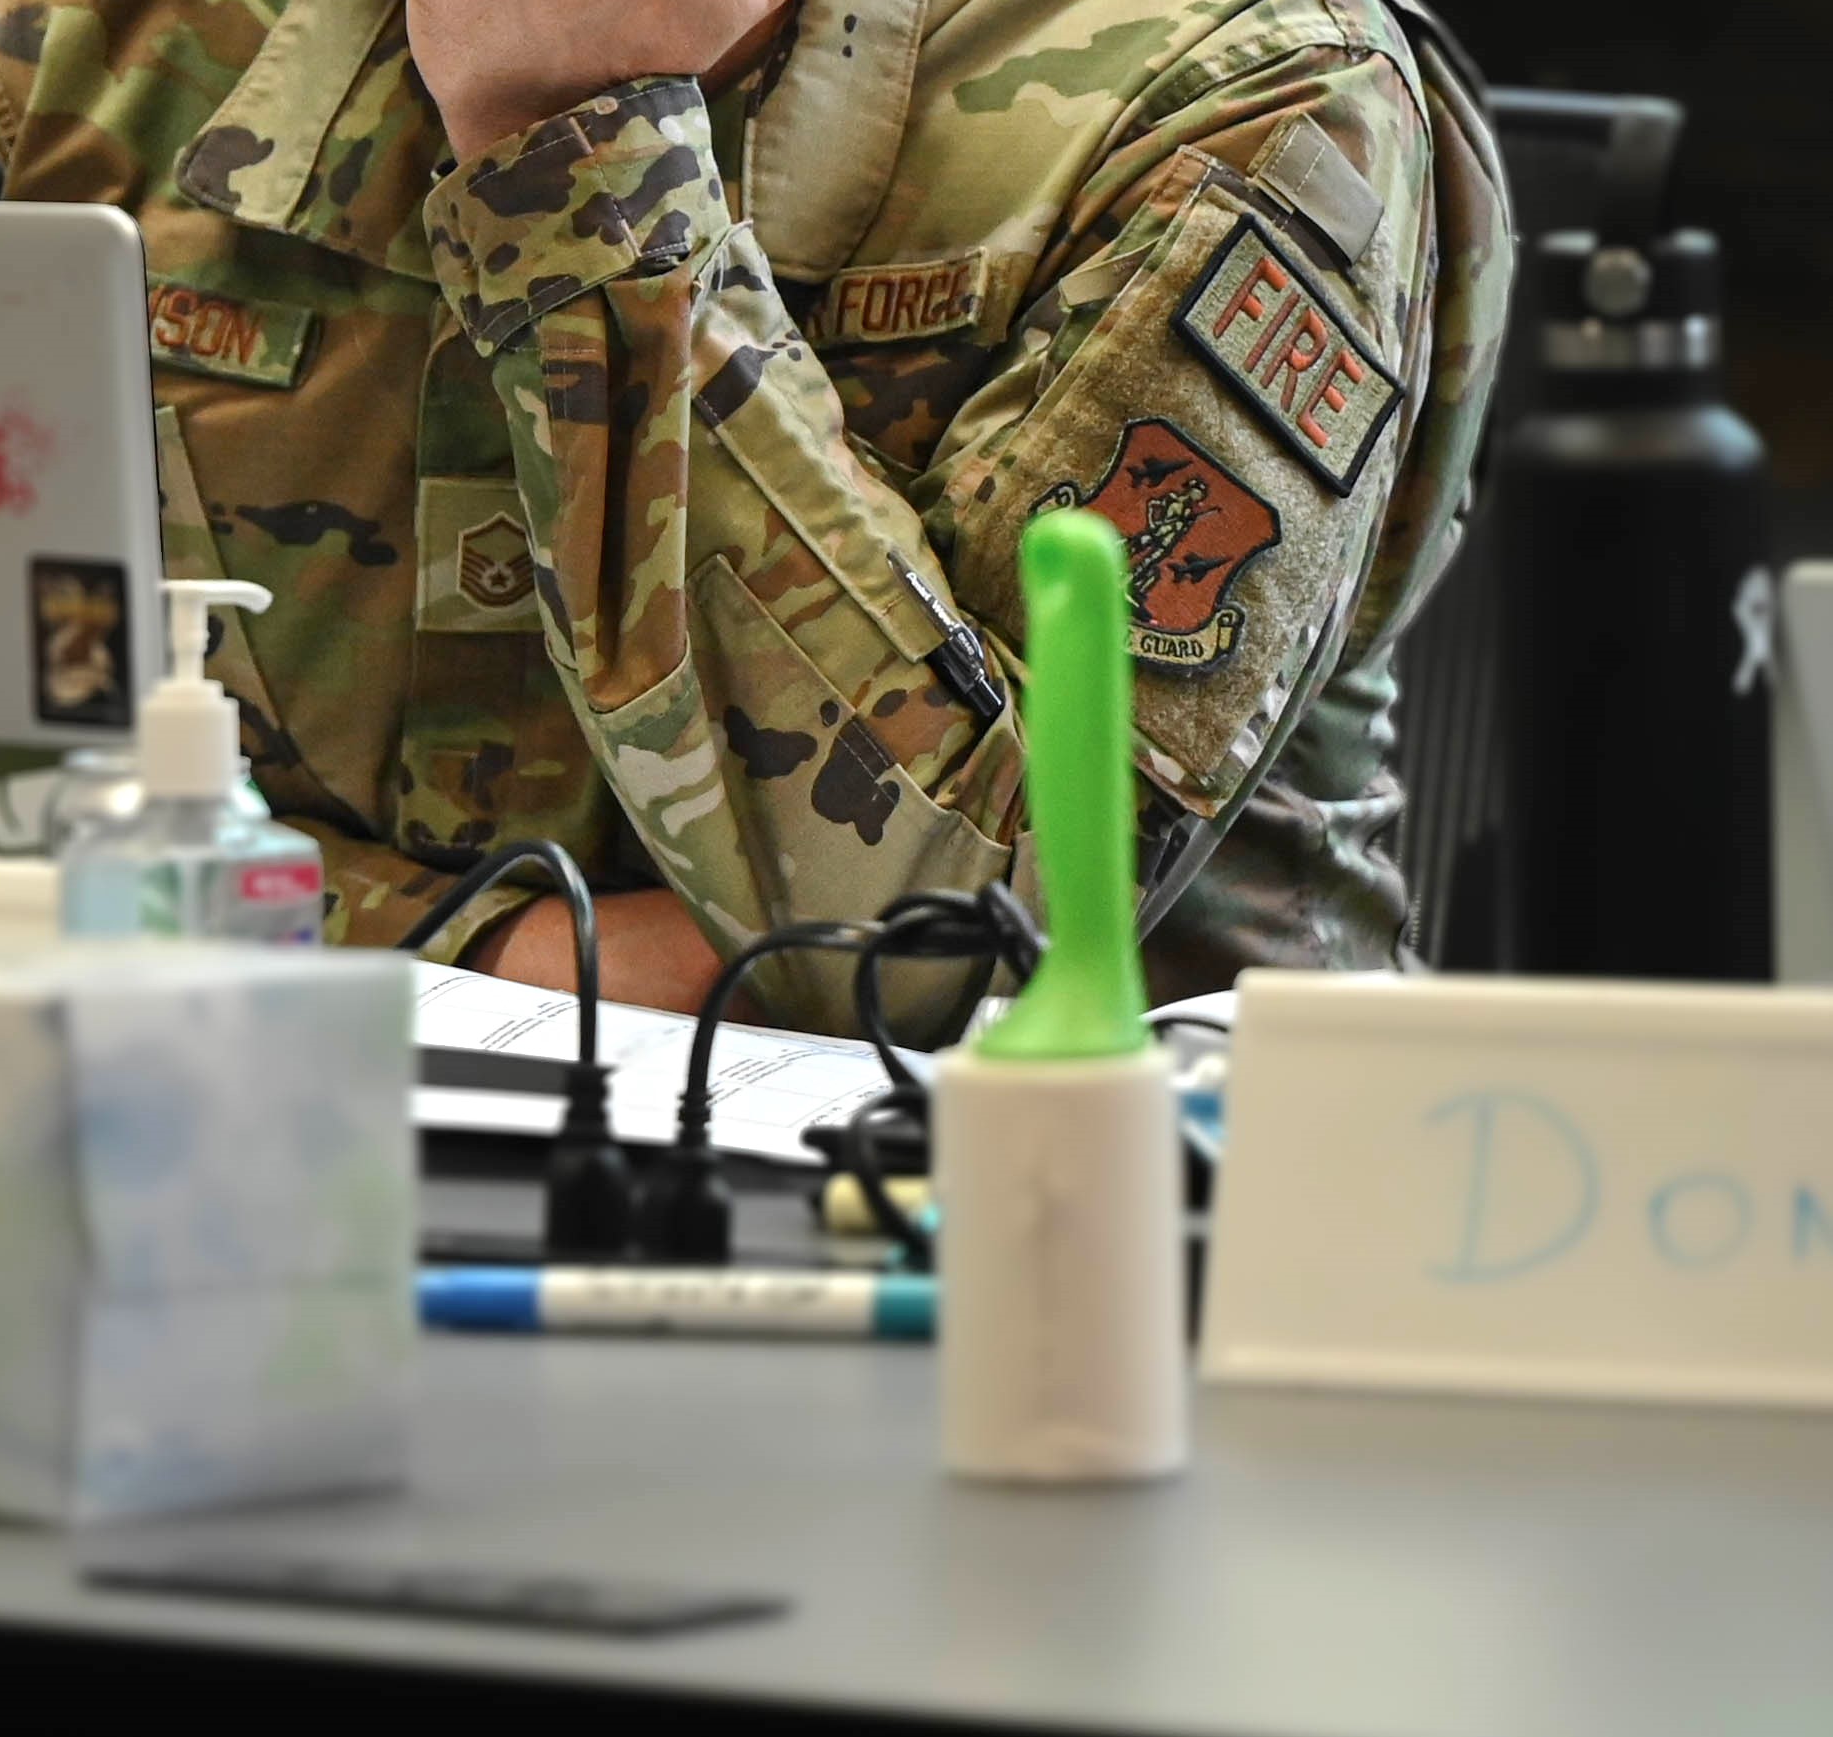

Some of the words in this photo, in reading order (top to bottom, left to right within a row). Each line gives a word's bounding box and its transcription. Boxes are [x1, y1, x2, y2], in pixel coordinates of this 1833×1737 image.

[149, 284, 267, 366] SON
[1212, 255, 1365, 449] FIRE
[1140, 635, 1205, 659] GUARD
